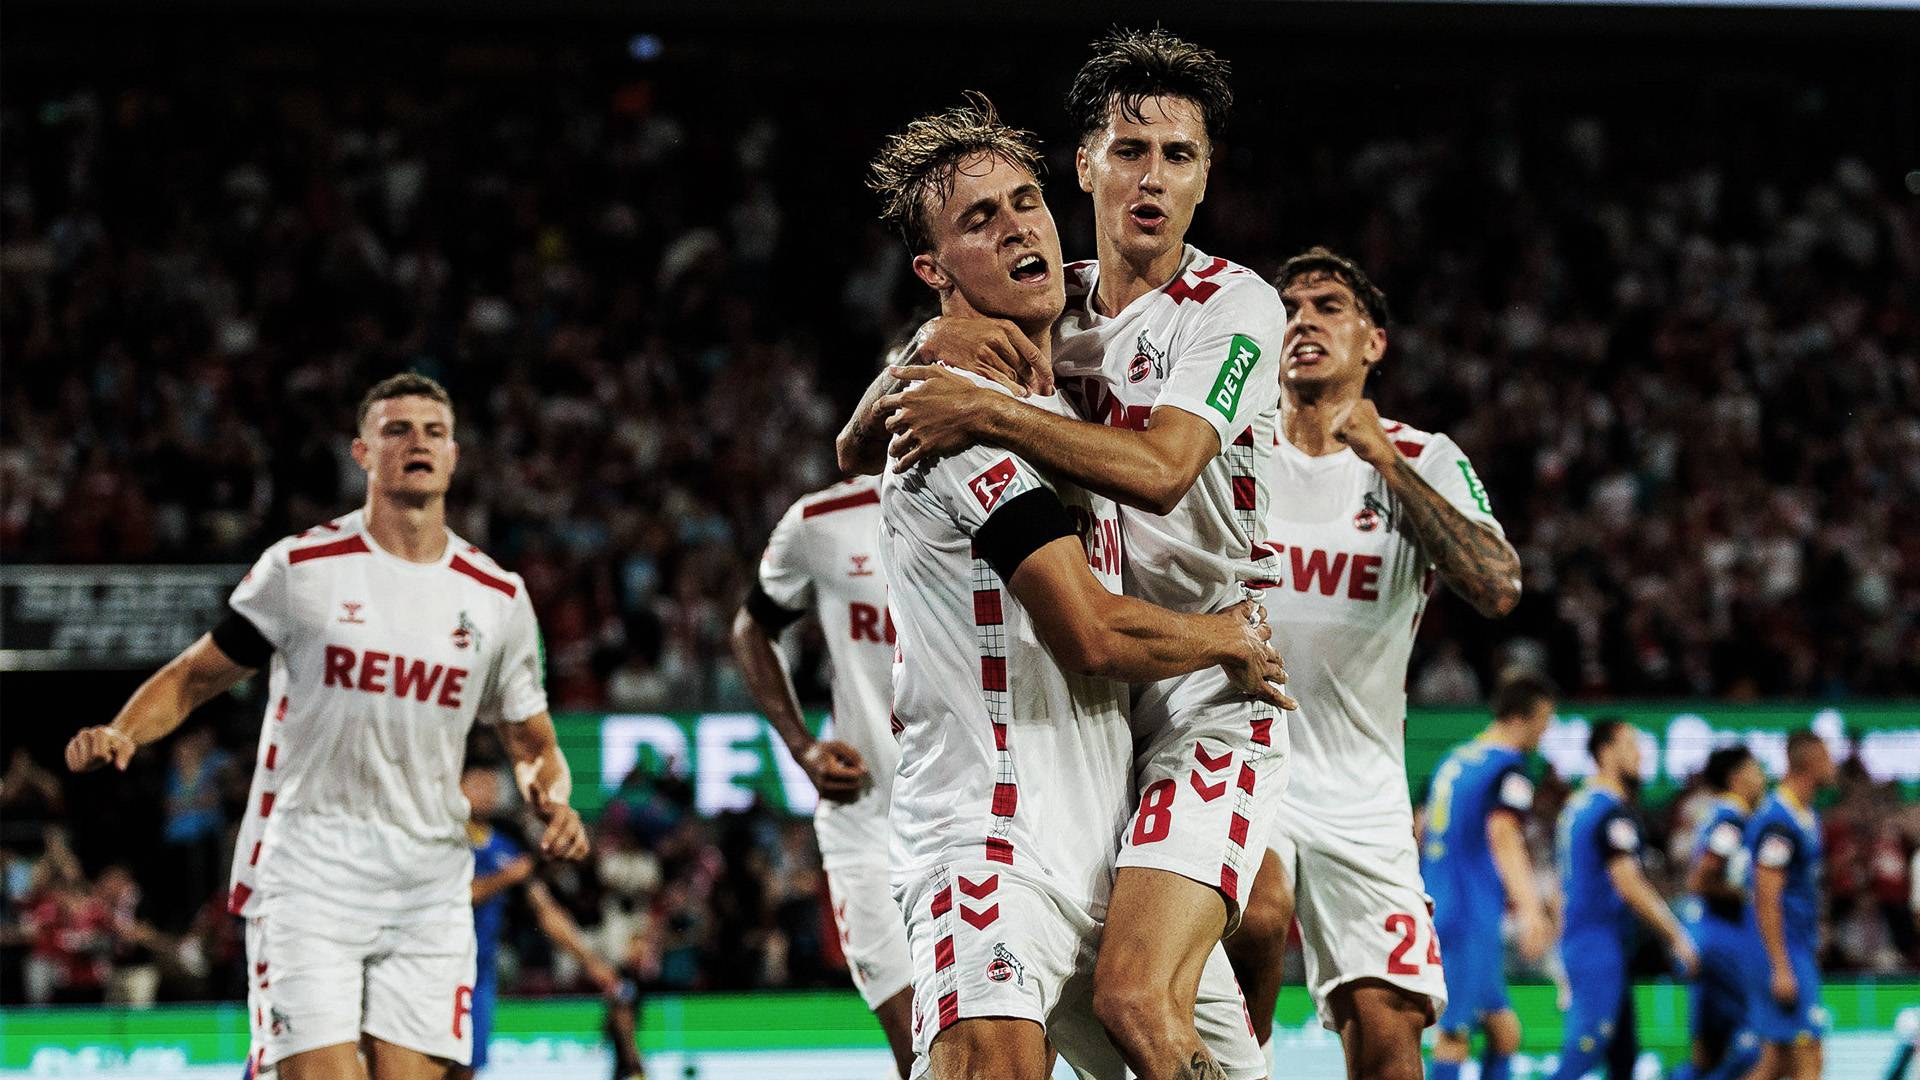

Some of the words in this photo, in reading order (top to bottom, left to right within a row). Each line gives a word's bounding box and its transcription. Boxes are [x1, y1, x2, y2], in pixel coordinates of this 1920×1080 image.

[325, 644, 468, 707] REWE
[601, 713, 834, 816] DEV
[1132, 778, 1176, 846] 8
